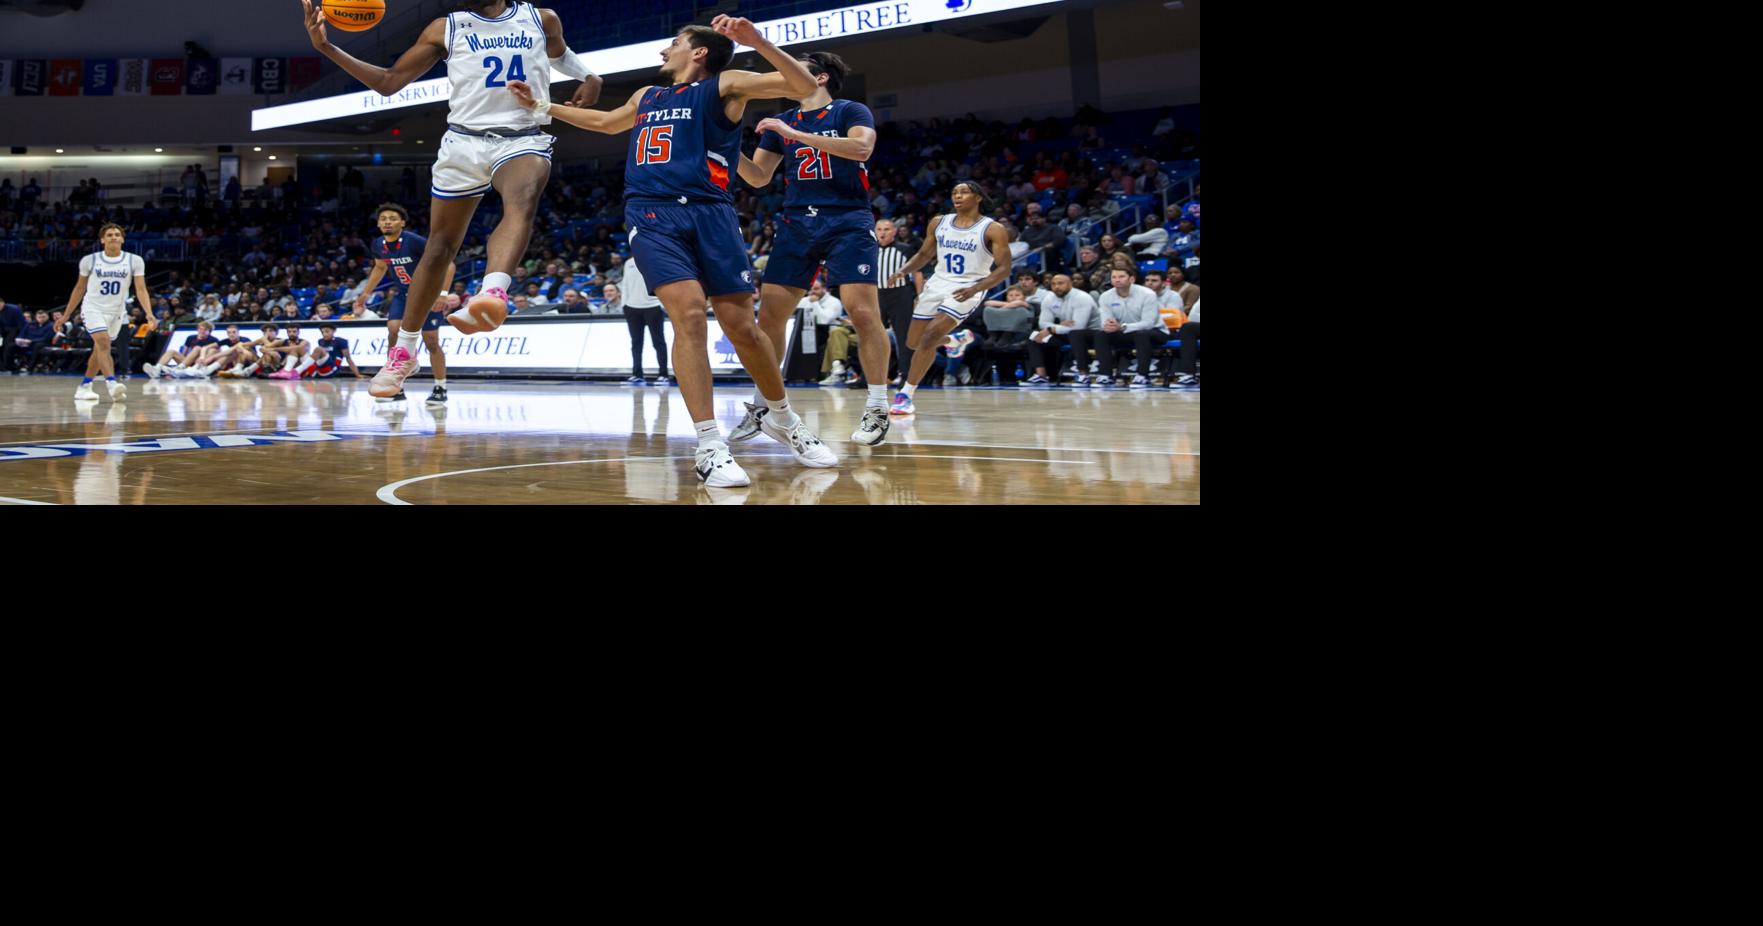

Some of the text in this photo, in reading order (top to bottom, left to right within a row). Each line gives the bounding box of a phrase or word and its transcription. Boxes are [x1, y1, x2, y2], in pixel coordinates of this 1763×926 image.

[334, 10, 375, 21] Wilson
[752, 2, 912, 46] UBLETREE
[465, 30, 533, 53] Mavericks
[92, 63, 108, 88] UTA
[261, 57, 280, 92] CBU
[483, 54, 526, 88] 24
[646, 107, 692, 123] TYLER
[635, 124, 674, 166] 15
[795, 147, 833, 181] 21
[936, 234, 977, 253] Mavericks
[393, 265, 412, 285] 5
[943, 252, 965, 275] 13
[100, 280, 121, 296] 30
[456, 336, 531, 356] HOTEL
